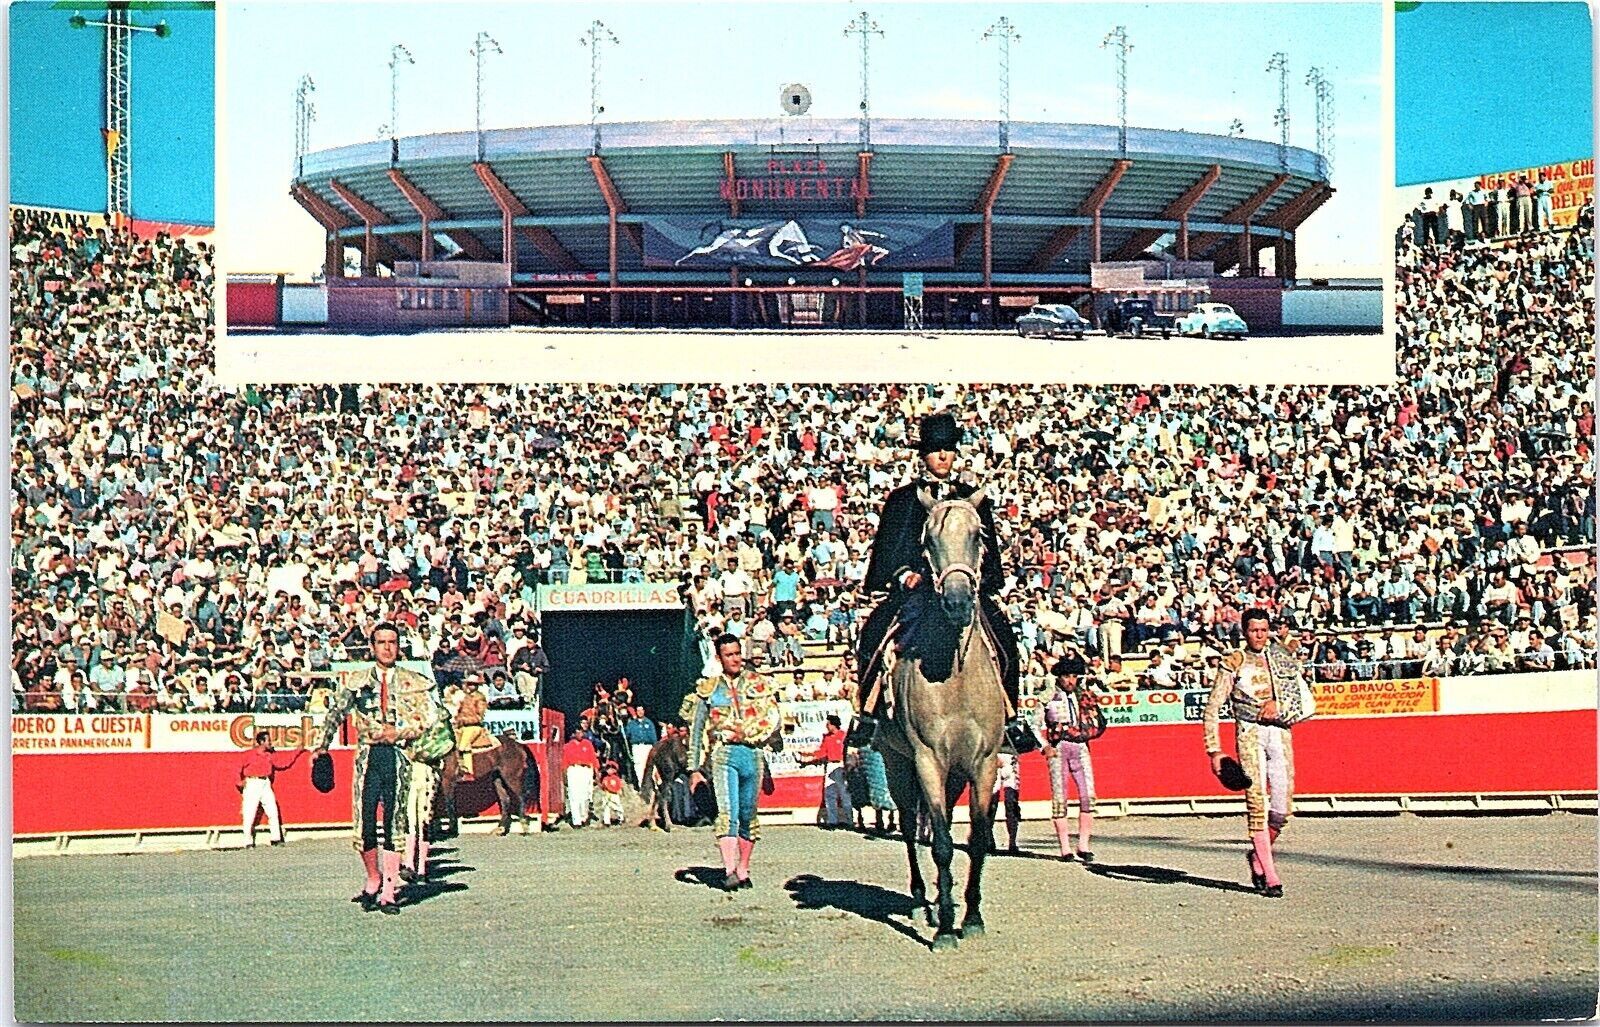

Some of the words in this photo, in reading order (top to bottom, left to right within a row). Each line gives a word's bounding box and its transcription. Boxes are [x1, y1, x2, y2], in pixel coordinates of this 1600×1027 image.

[768, 160, 827, 173] PLAZA
[719, 177, 874, 199] MONUMENTAL
[9, 207, 90, 228] OMPANY
[549, 589, 678, 604] CUADRILLAS
[1322, 684, 1345, 695] RIO
[1099, 693, 1139, 706] OIL
[1148, 692, 1181, 704] CO.
[65, 717, 85, 733] LA
[92, 716, 143, 733] CUESTA
[170, 720, 228, 732] ORANGE
[60, 738, 132, 748] PANAMERICANA
